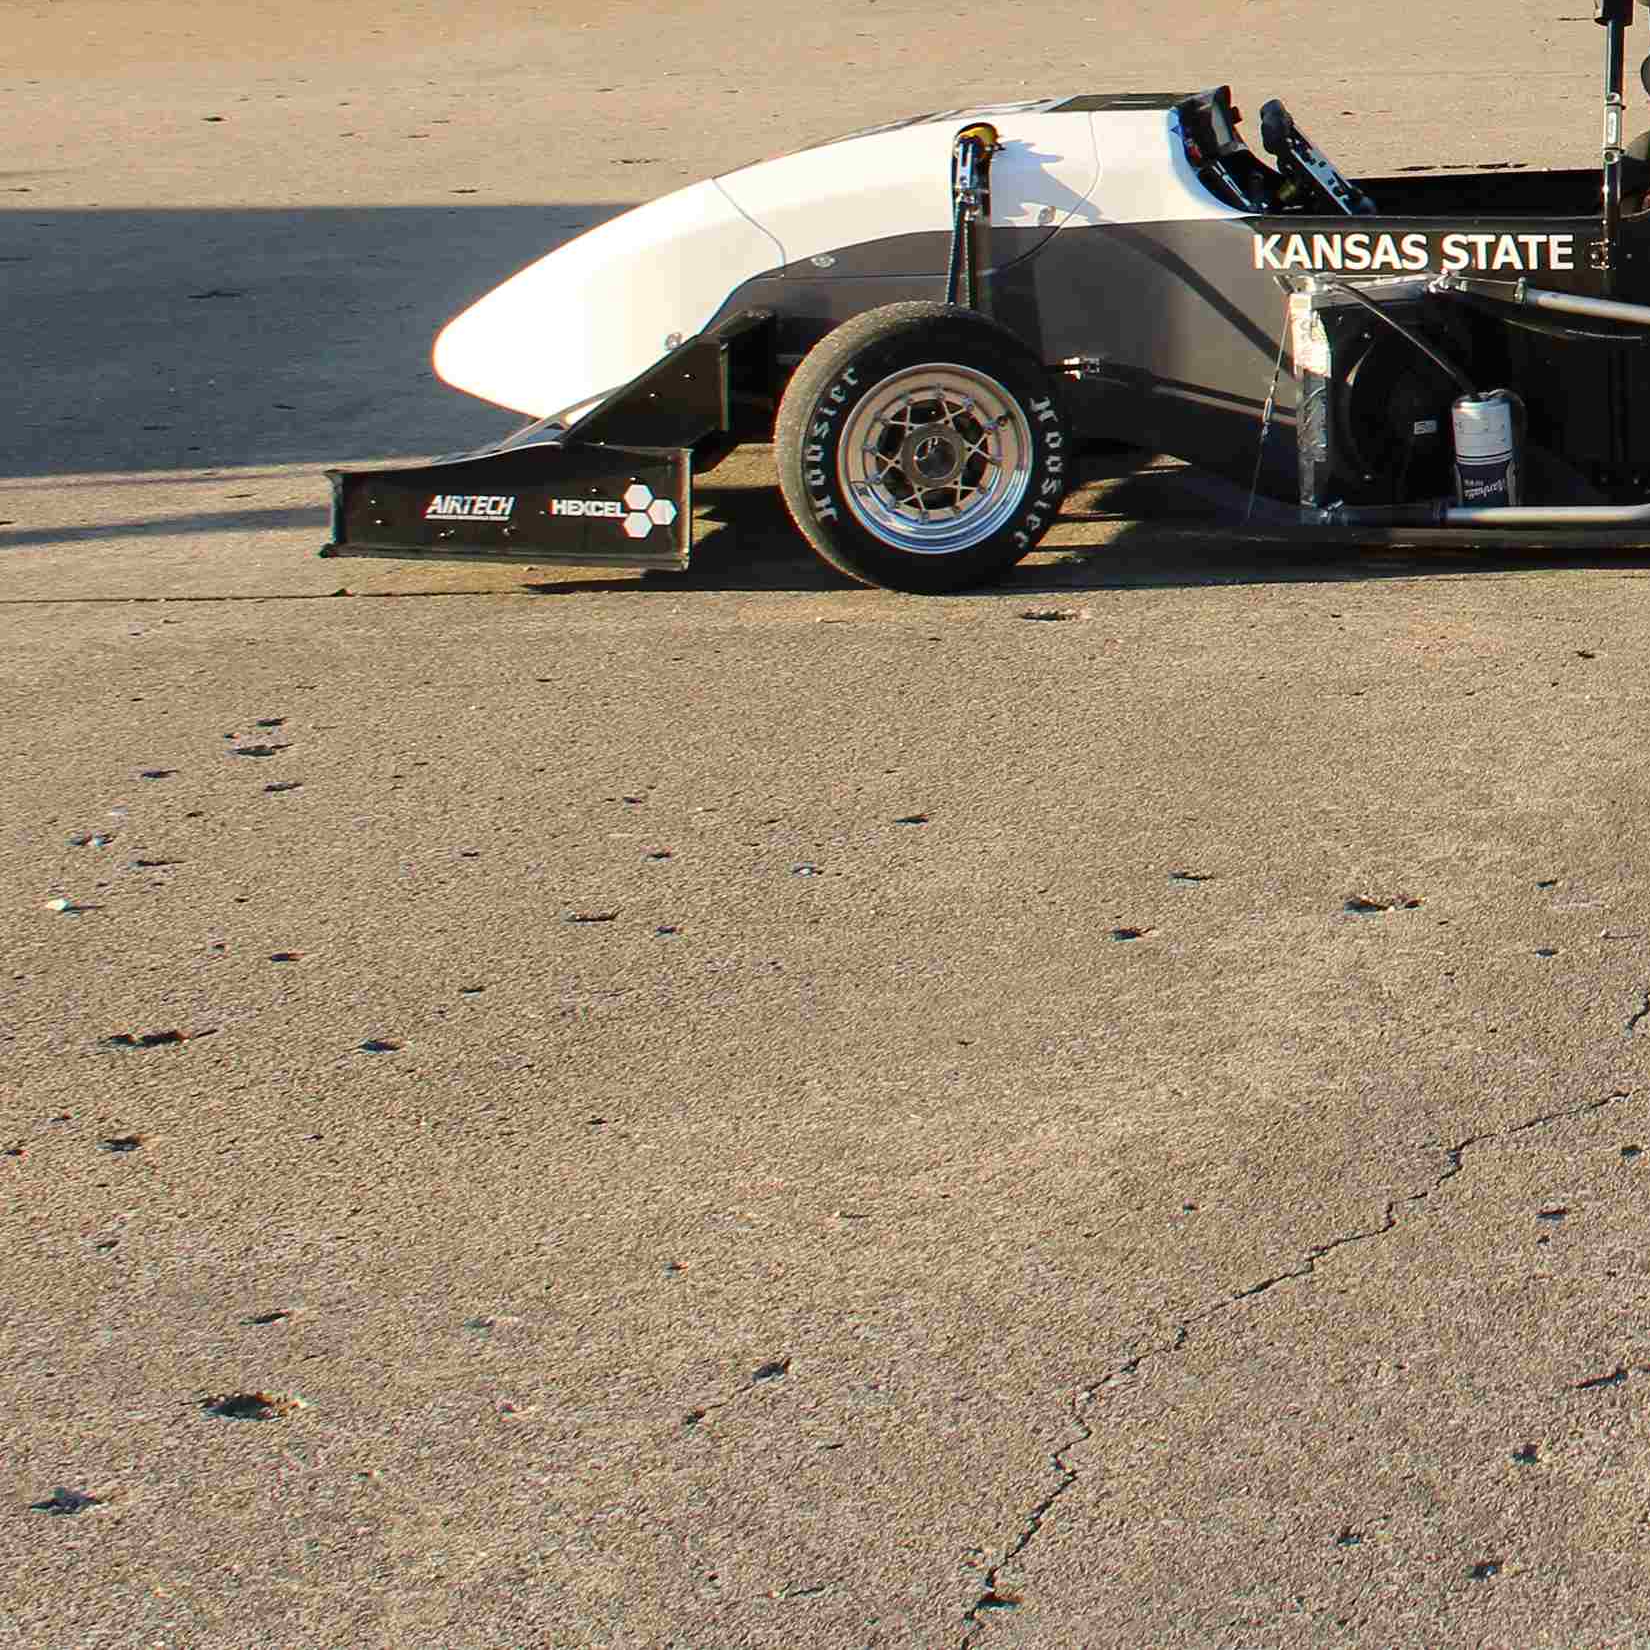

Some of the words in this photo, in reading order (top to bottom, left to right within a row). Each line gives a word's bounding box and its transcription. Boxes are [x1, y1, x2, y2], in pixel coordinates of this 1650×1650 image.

[1253, 233, 1429, 270] KANSAS
[1441, 233, 1575, 270] STATE
[424, 494, 516, 515] AIRTECH
[551, 498, 629, 518] HEXCEL
